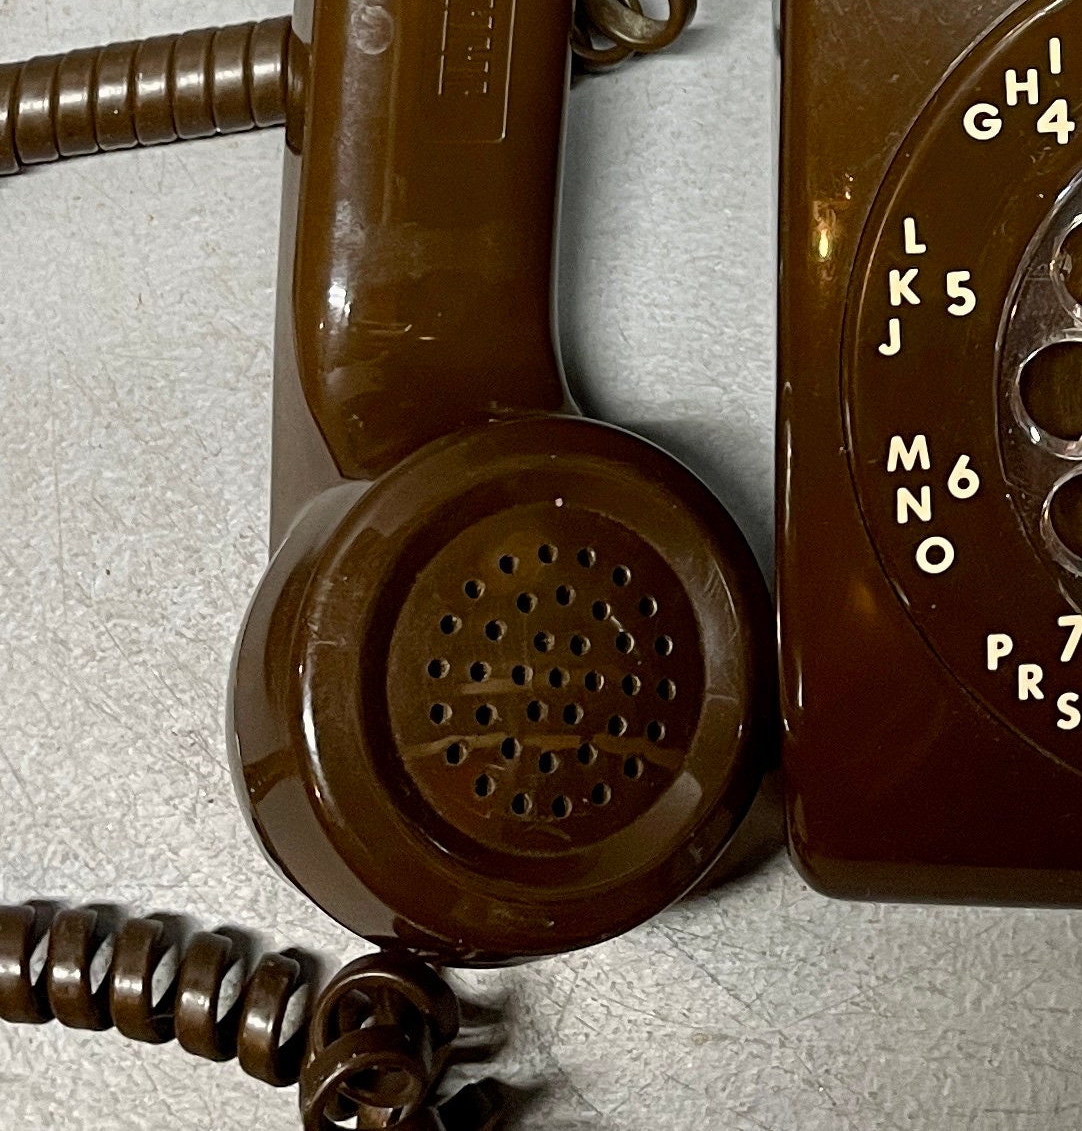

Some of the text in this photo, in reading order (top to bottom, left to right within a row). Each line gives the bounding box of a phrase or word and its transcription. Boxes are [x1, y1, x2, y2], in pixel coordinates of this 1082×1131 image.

[1034, 94, 1076, 145] 4
[946, 270, 977, 316] 5
[947, 454, 980, 499] 6
